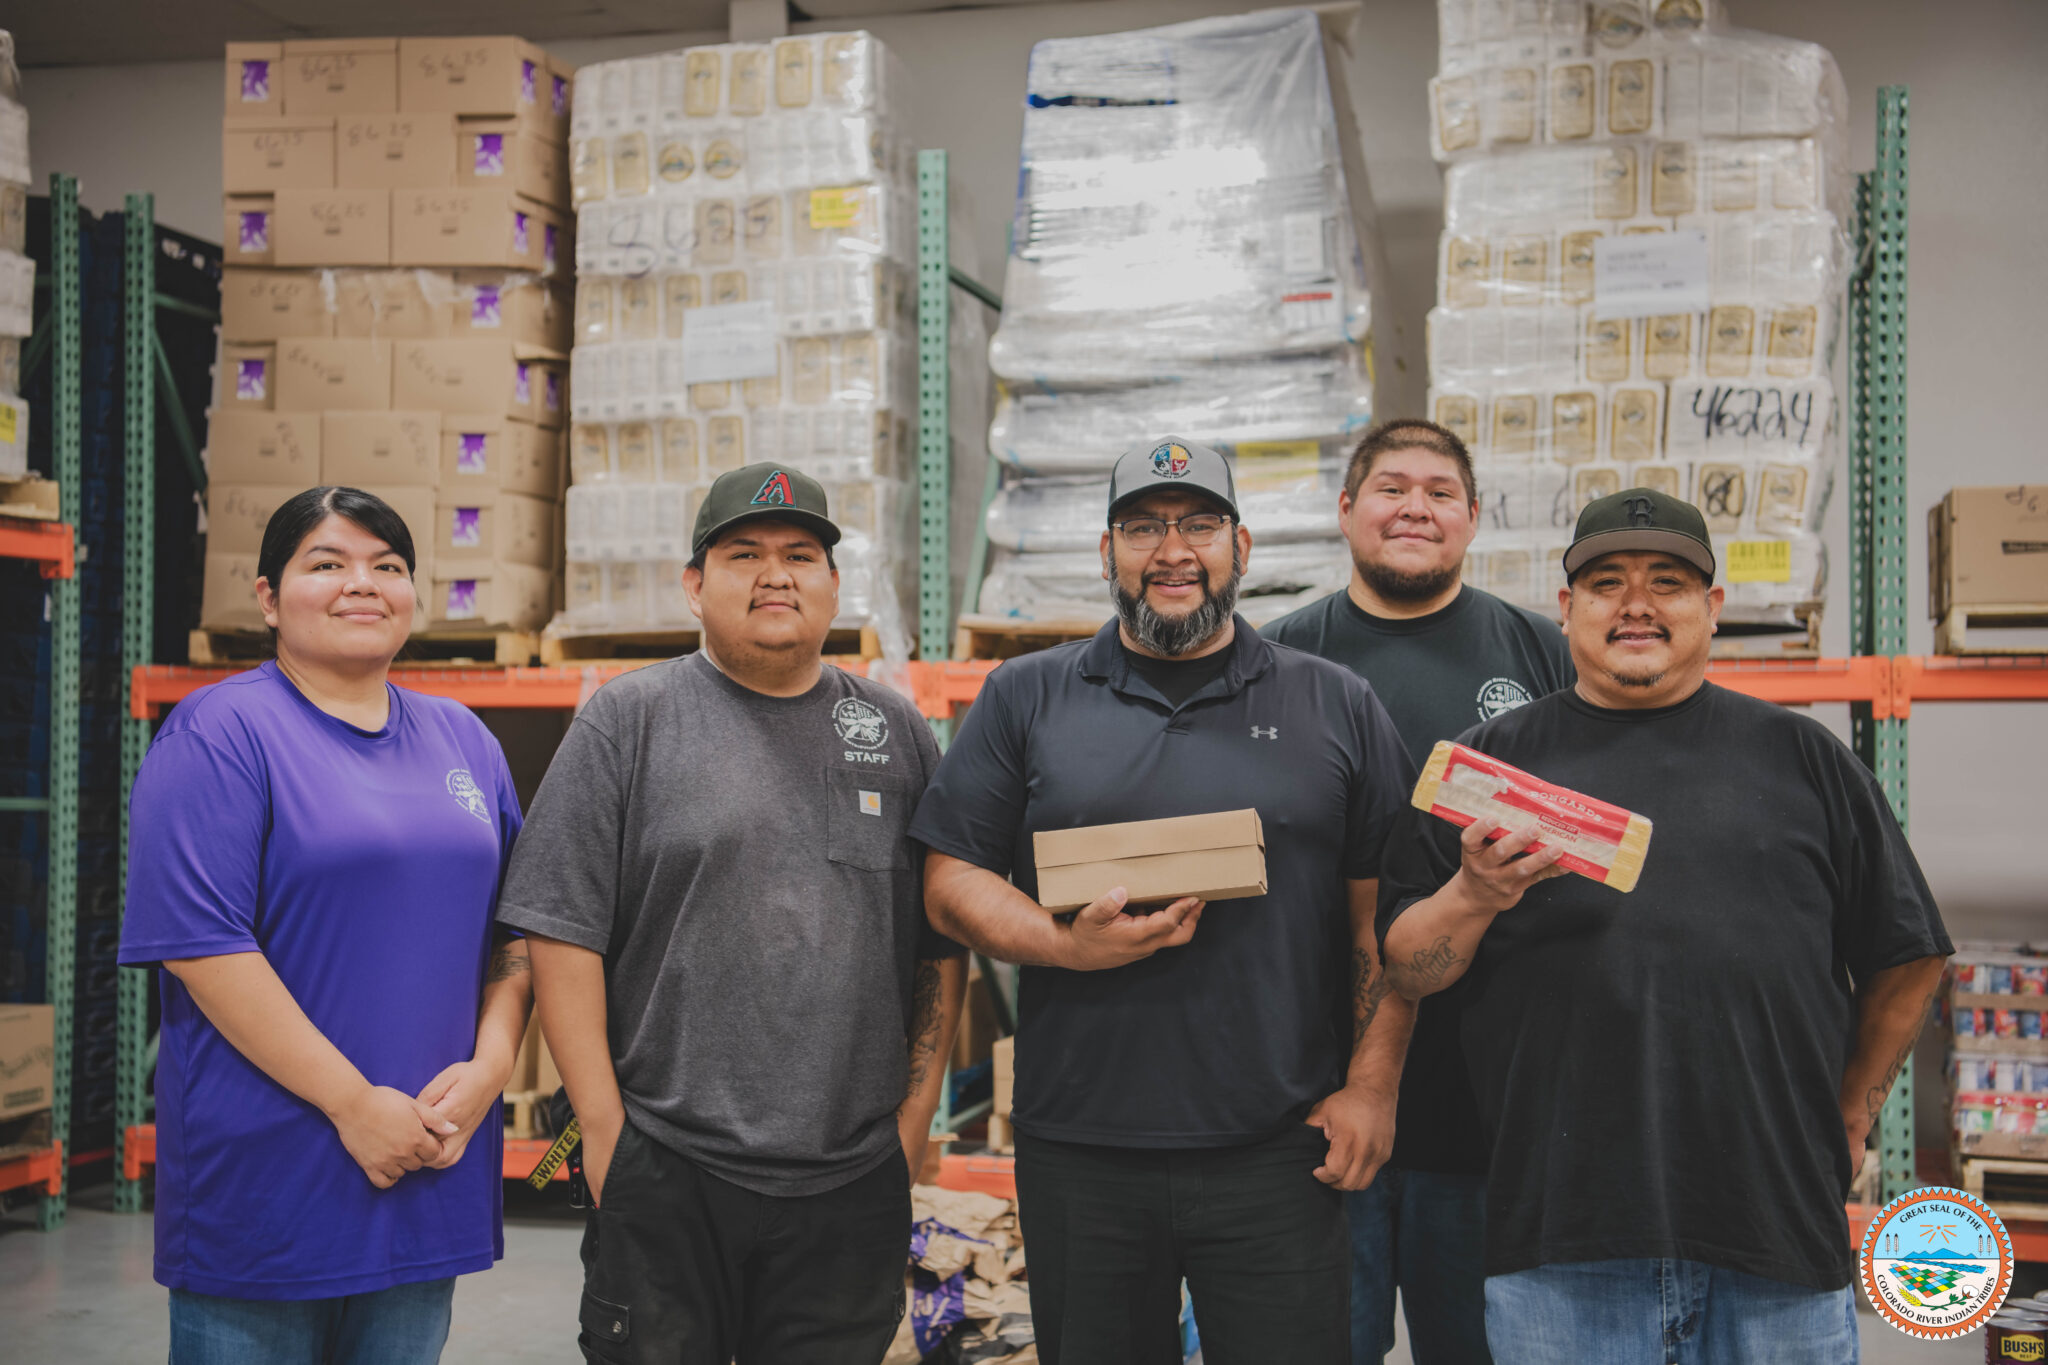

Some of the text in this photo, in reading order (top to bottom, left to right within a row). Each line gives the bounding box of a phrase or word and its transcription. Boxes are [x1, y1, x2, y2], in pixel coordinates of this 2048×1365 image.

[1692, 386, 1813, 448] 46224
[844, 750, 890, 765] STAFF
[2003, 1339, 2044, 1355] BUSH'S
